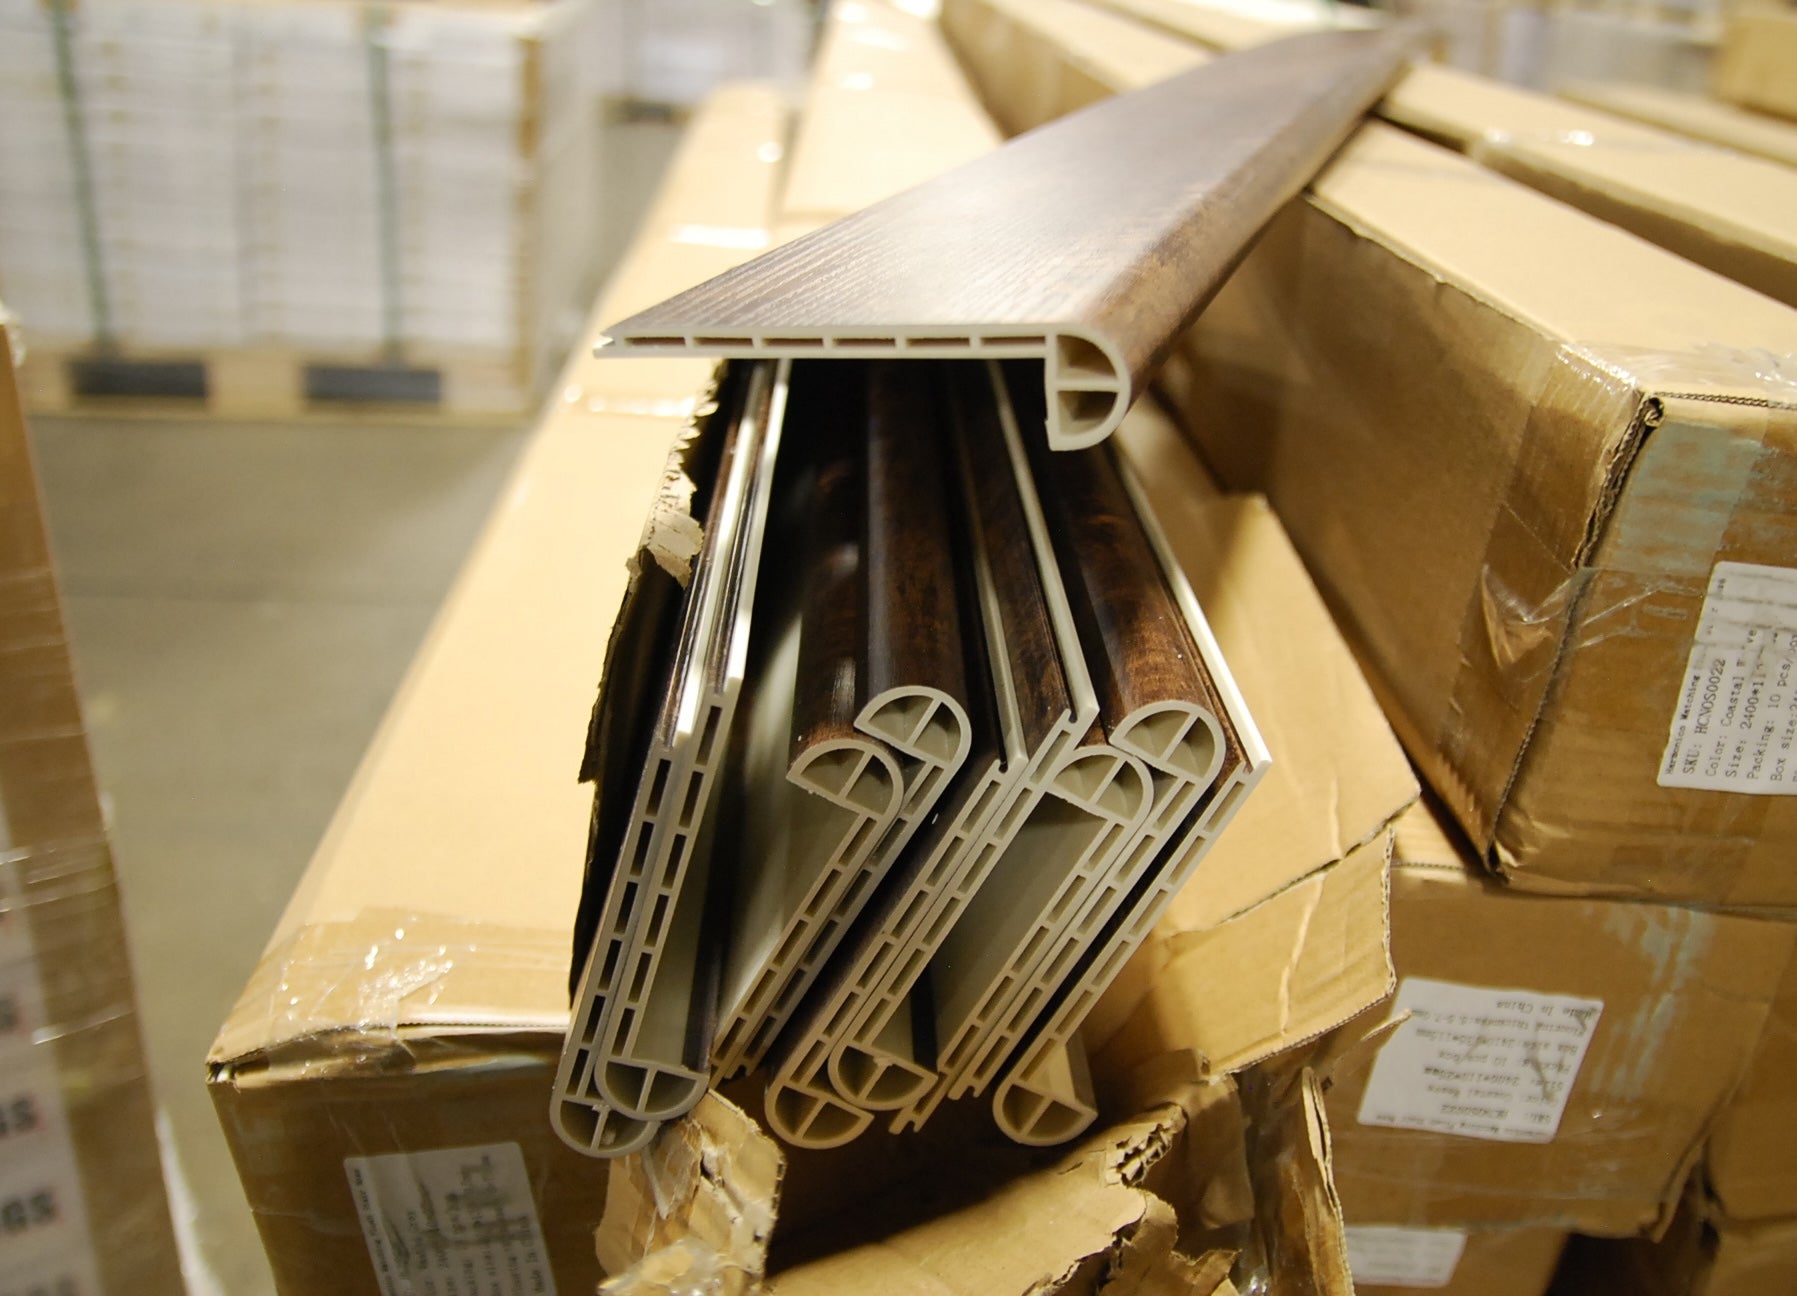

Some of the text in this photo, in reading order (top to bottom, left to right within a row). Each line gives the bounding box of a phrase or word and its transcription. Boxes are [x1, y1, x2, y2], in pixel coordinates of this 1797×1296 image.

[1704, 676, 1745, 777] Color: Coastal
[1745, 719, 1775, 780] Packing:
[1766, 693, 1782, 709] 10
[1682, 743, 1702, 775] SKU:
[1724, 739, 1746, 778] Size:
[1770, 756, 1788, 783] Box
